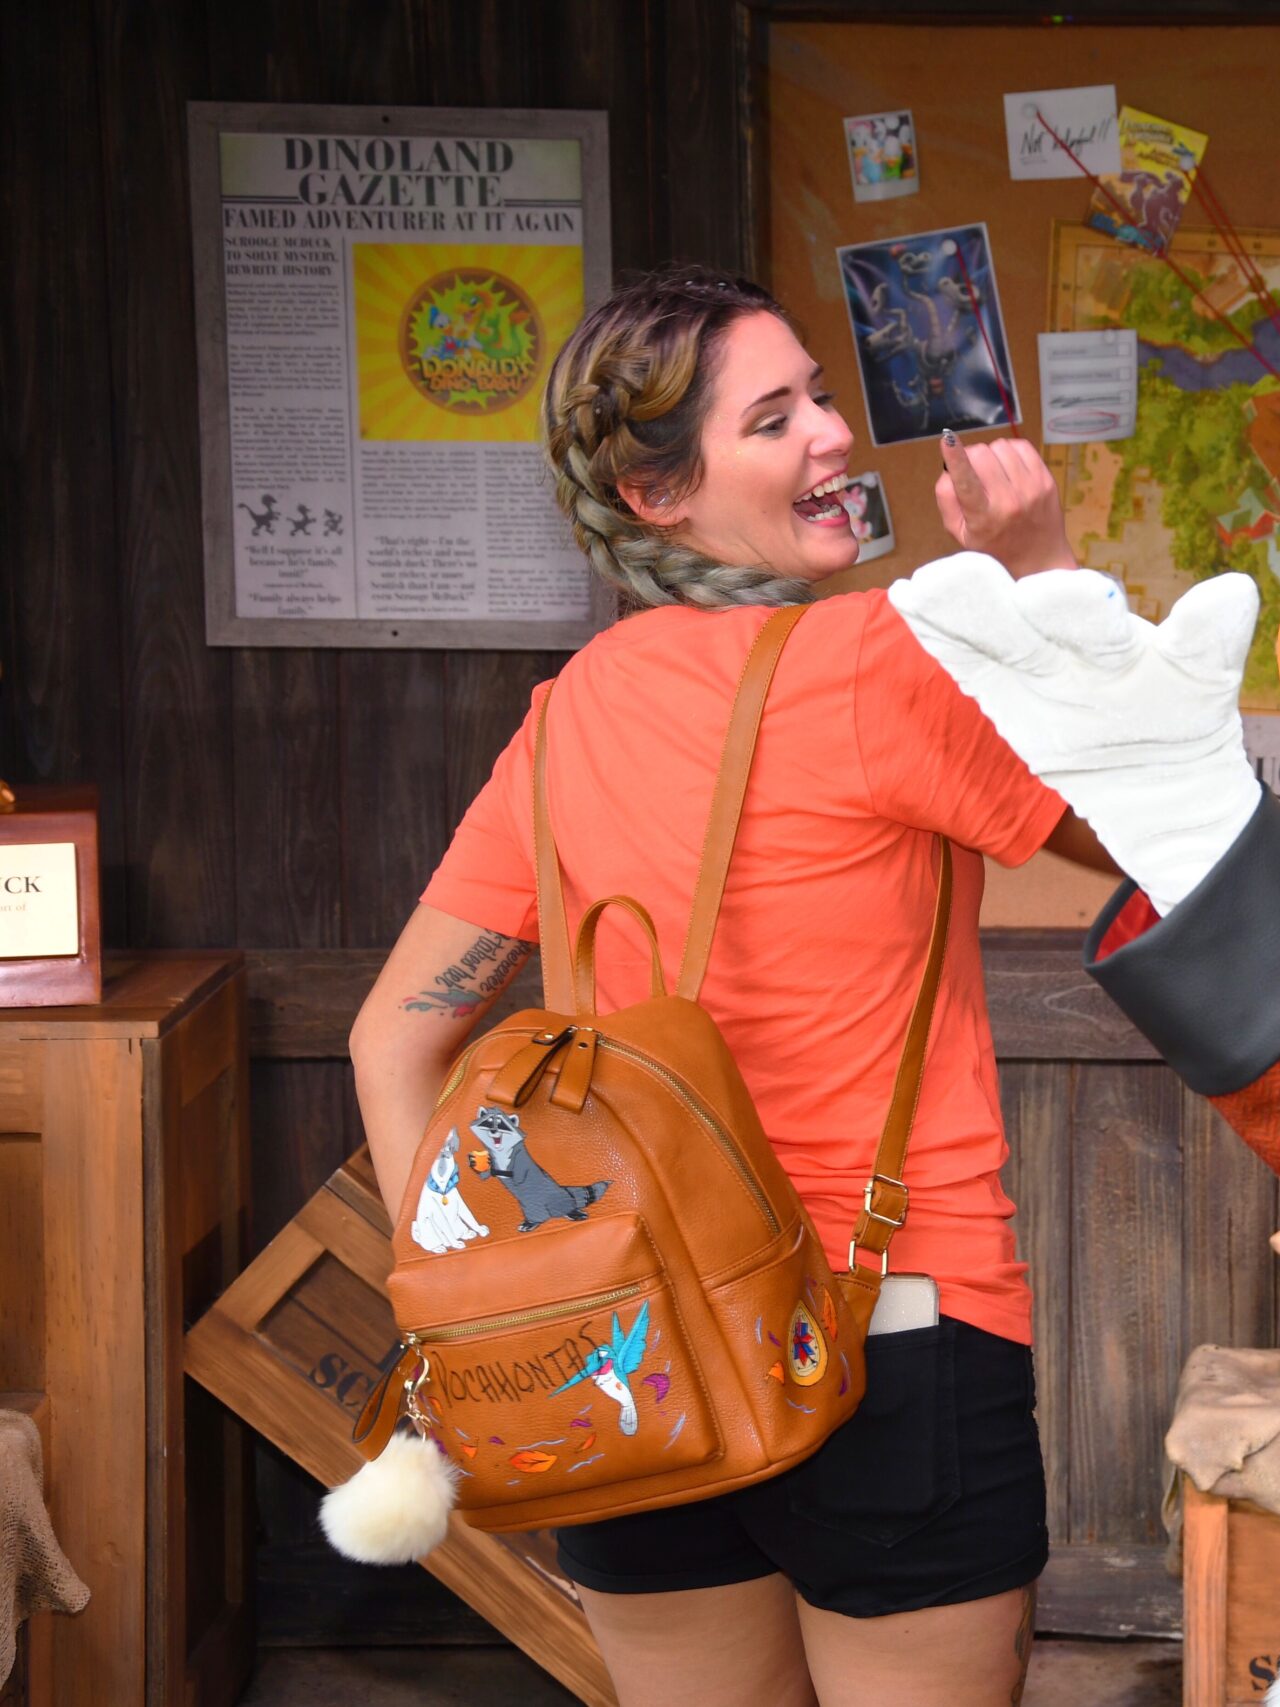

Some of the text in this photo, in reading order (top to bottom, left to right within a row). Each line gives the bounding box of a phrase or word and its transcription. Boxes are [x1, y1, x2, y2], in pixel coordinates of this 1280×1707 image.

[284, 138, 514, 173] DINOLAND
[299, 172, 502, 207] GAZETTE
[224, 208, 575, 233] FAMED ADVENTURER AT IT AGAIN
[225, 237, 333, 248] SCROOGE MCDUCK
[226, 251, 241, 261] TO
[244, 251, 279, 261] SOLVE
[226, 265, 333, 276] REWRITE HISTORY
[431, 1321, 600, 1408] POCAHONTAS
